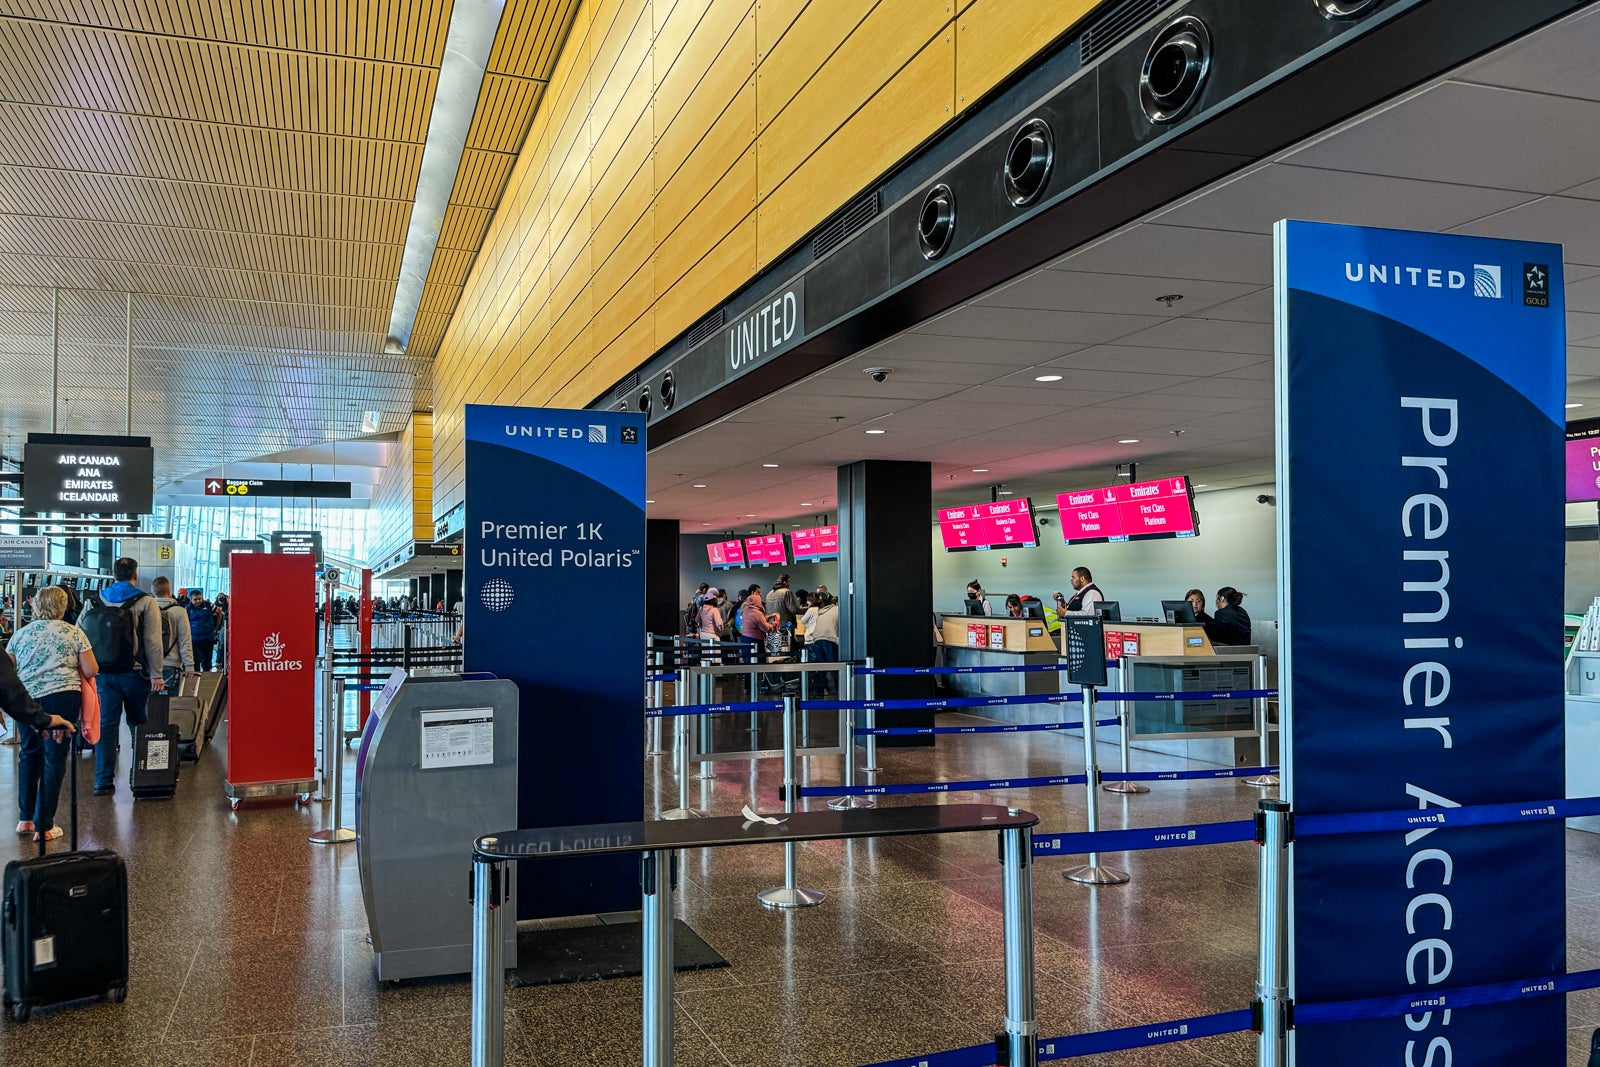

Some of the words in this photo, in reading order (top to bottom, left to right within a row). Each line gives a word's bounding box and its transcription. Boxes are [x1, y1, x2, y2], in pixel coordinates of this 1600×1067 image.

[1345, 262, 1465, 289] UNITED
[1526, 296, 1546, 306] GOLD
[730, 291, 796, 370] UNITED
[505, 425, 584, 438] UNITED
[58, 455, 77, 465] AIR
[79, 456, 120, 466] CANADA
[78, 468, 100, 477] ANA
[65, 480, 113, 490] EMIRATES
[1130, 484, 1160, 498] Emirates
[60, 492, 118, 502] ICELANDAIR
[1069, 493, 1094, 506] Emirates
[989, 504, 1010, 514] Emirates
[1140, 505, 1151, 514] First
[1152, 504, 1165, 512] Class
[947, 510, 965, 519] Emirates
[1088, 511, 1099, 519] Class
[1144, 517, 1166, 526] Platinum
[481, 521, 567, 540] Premier
[576, 522, 603, 540] 1K
[1081, 523, 1100, 531] Platinum
[481, 549, 552, 567] United
[561, 550, 632, 567] Polaris
[1401, 396, 1458, 748] Premier
[244, 659, 302, 672] Emirates
[1520, 807, 1548, 816] UNITED
[1407, 815, 1438, 824] UNITED
[1154, 832, 1187, 842] UNITED
[1034, 840, 1051, 849] TED
[1521, 985, 1548, 994] UNITED
[1410, 999, 1438, 1008] UNITED
[1147, 1026, 1179, 1039] UNITED
